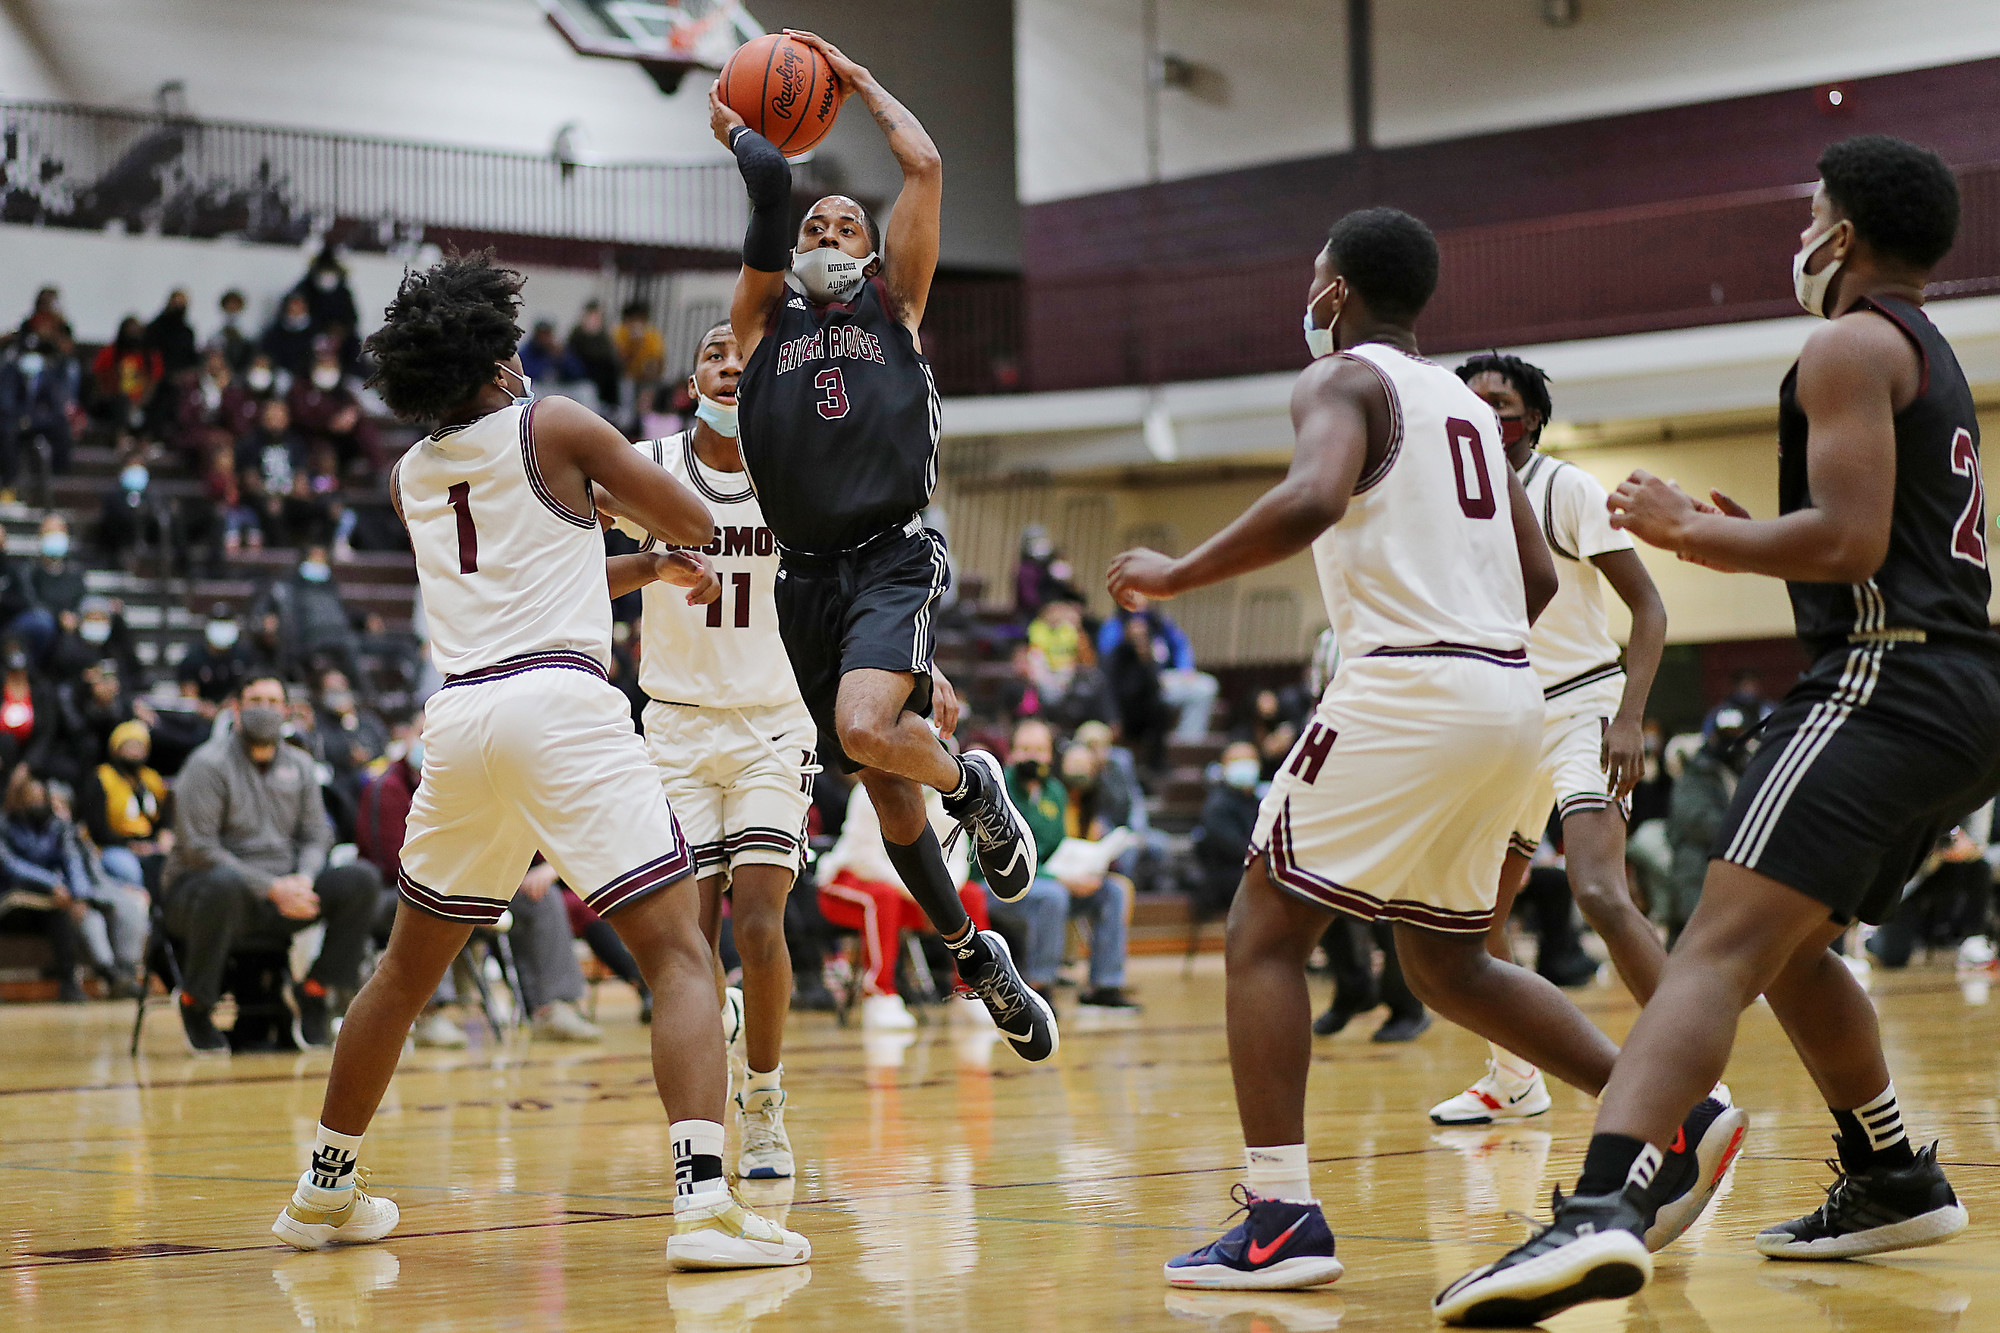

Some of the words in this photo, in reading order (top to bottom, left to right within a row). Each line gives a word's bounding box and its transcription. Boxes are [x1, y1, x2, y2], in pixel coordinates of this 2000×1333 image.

[772, 46, 804, 119] Rawlings
[817, 75, 835, 123] MHSAA
[777, 328, 825, 376] RIVER
[829, 324, 887, 366] ROUGE
[814, 367, 851, 420] 3
[1445, 416, 1497, 520] 0
[1950, 426, 1987, 570] 2
[447, 480, 479, 575] 1
[706, 572, 751, 628] 11
[1288, 721, 1339, 787] H
